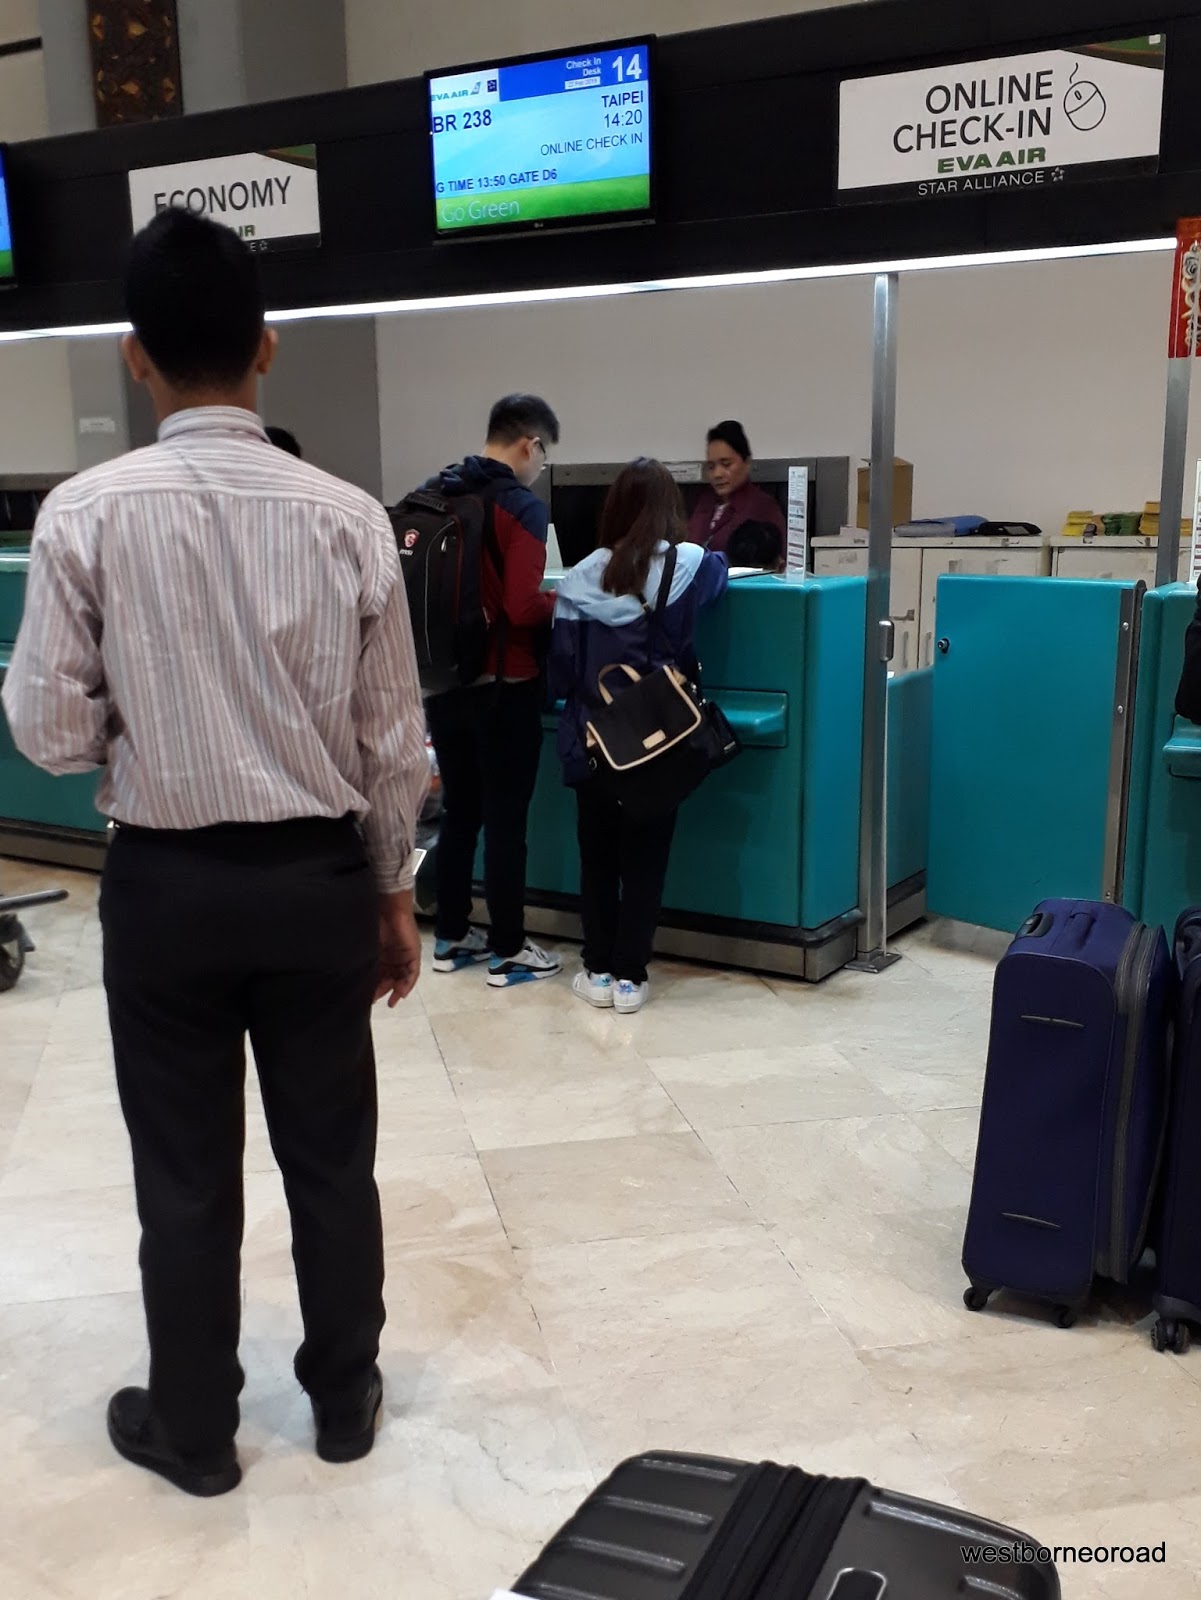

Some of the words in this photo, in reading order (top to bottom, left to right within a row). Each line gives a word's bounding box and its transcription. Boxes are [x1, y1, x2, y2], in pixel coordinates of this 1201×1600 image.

[566, 59, 592, 70] Check
[593, 57, 602, 65] In
[582, 67, 602, 77] Desk
[611, 53, 643, 83] 14
[450, 89, 469, 99] AIR
[601, 90, 644, 108] TAIPEI
[925, 69, 1053, 115] ONLINE
[433, 114, 457, 134] BR
[462, 109, 492, 129] 238
[603, 109, 643, 129] 14:20
[893, 106, 1052, 154] CHECK-IN
[540, 139, 583, 156] ONLINE
[586, 134, 628, 151] CHECK
[631, 132, 643, 145] IN
[937, 153, 993, 174] EVA
[995, 147, 1047, 169] AIR
[448, 178, 474, 192] TIME
[477, 174, 506, 189] 13:50
[509, 171, 539, 185] GATE
[542, 168, 558, 181] D6
[917, 178, 958, 196] STAR
[962, 170, 1045, 192] ALLIANCE
[154, 175, 291, 215] ECONOMY
[442, 204, 465, 222] Go
[468, 200, 520, 219] Green
